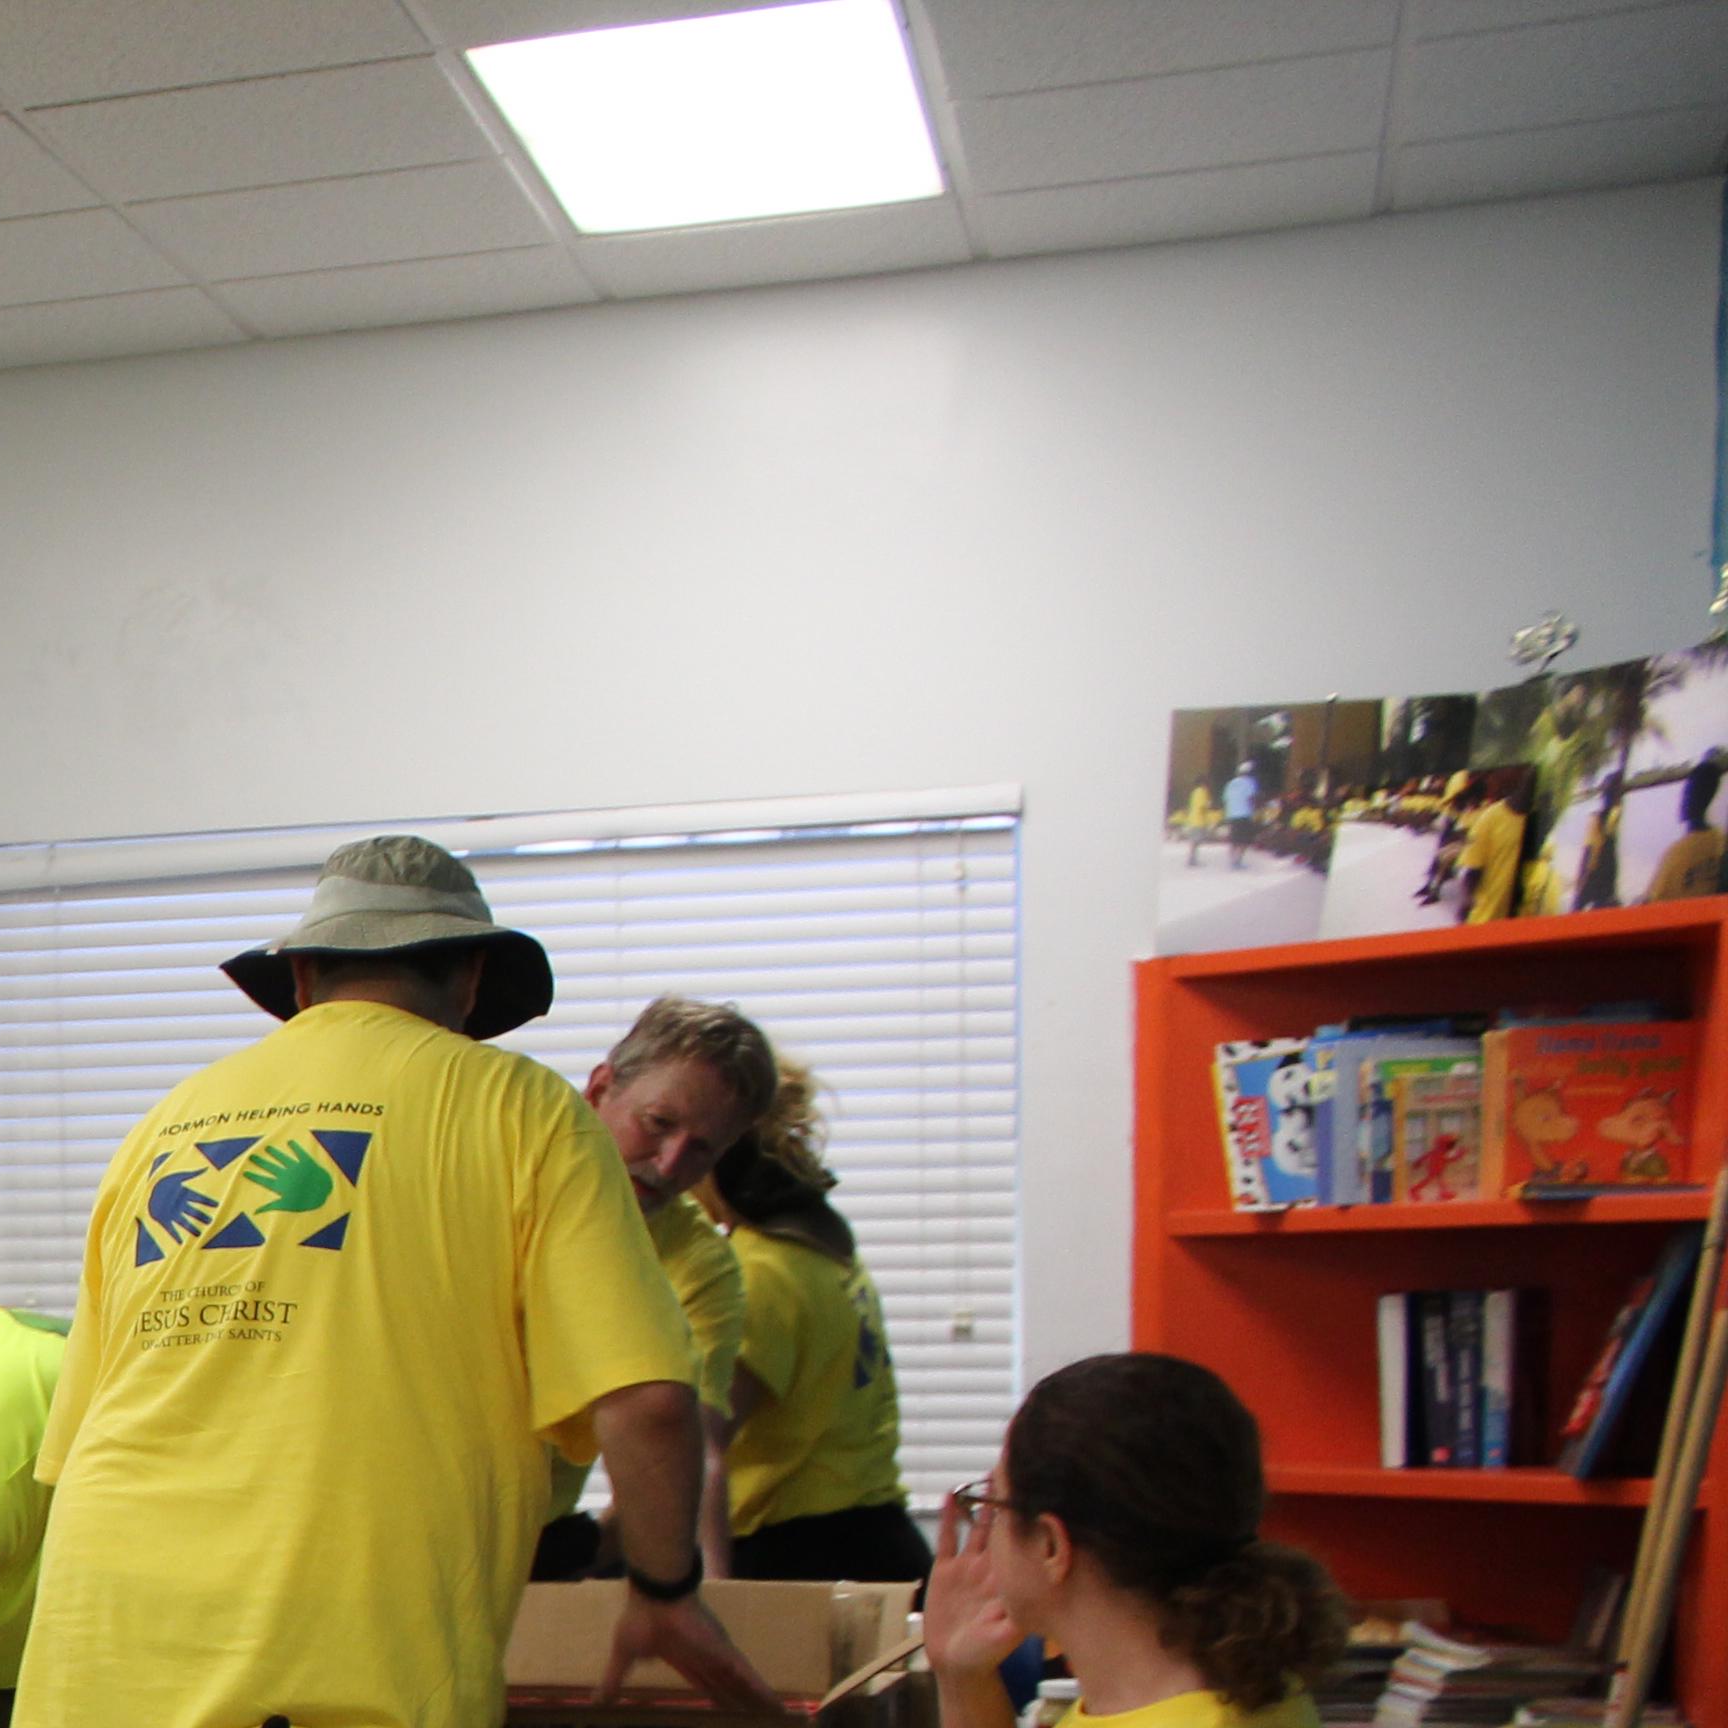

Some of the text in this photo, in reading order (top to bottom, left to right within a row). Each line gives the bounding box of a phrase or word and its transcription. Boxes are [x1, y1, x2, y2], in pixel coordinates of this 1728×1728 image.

[236, 1103, 312, 1121] HELPING
[317, 1102, 385, 1117] HANDS
[160, 1281, 266, 1302] THE CHURC OF
[199, 1299, 298, 1325] CHRIST
[228, 1327, 282, 1342] SAINTS
